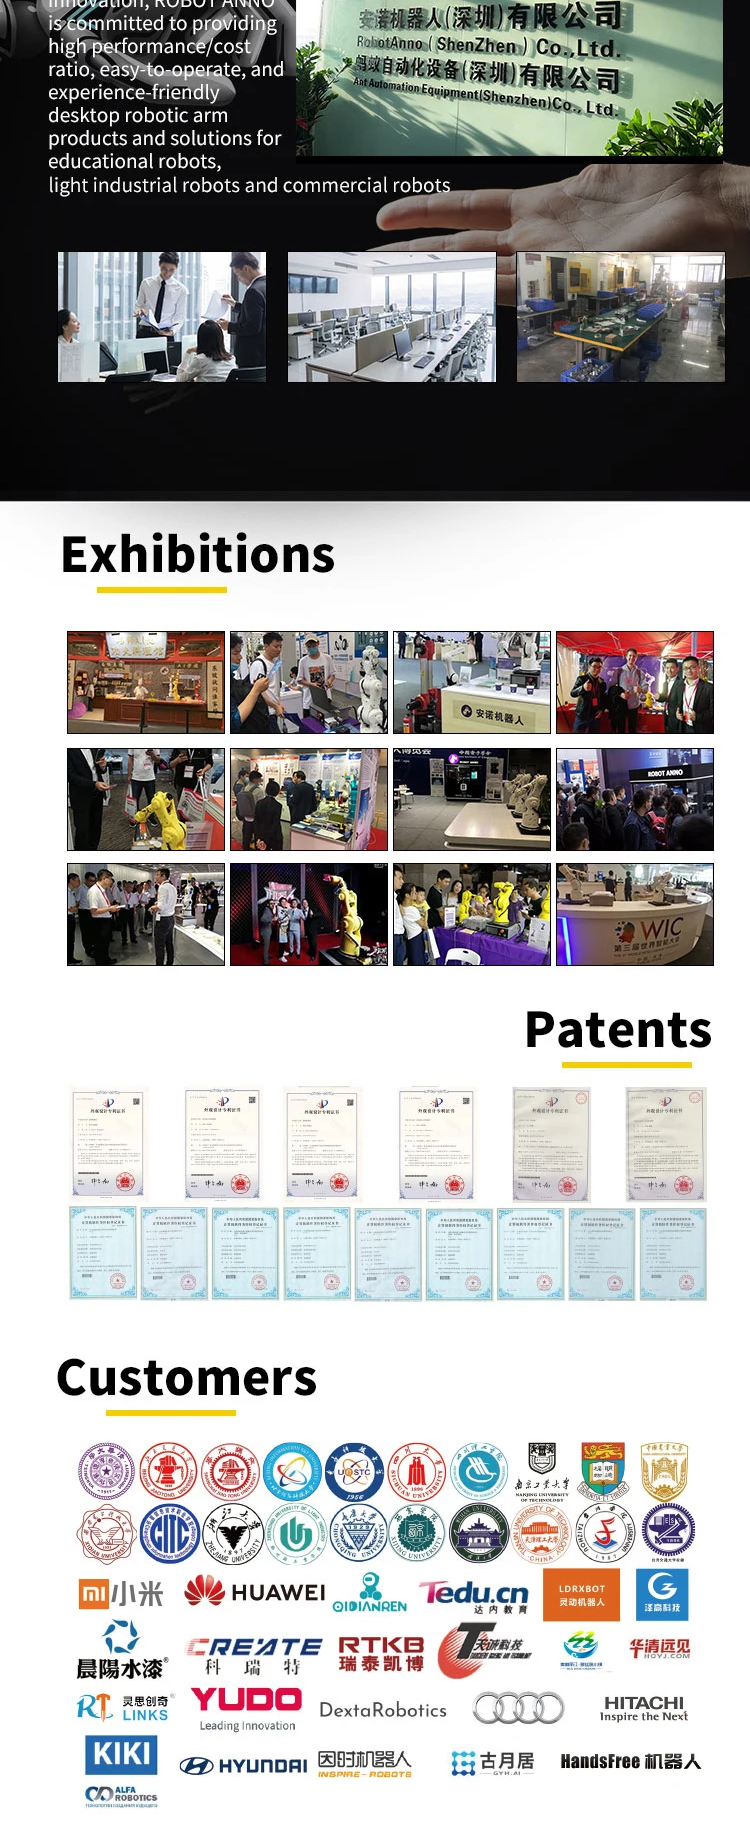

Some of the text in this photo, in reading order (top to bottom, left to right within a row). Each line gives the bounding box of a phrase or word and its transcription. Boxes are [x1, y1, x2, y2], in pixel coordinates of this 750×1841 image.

[359, 0, 621, 30] 安诺机器人(深圳)有限公司
[357, 36, 423, 51] RobotAnno
[437, 37, 516, 53] ShenZhen
[536, 37, 621, 58] Co.,Ltd.
[355, 54, 620, 94] 蚂蚁自动化设备(深圳)有限公司
[353, 76, 367, 87] Ant
[369, 78, 420, 93] Automation
[586, 101, 618, 117] Ltd.
[476, 708, 524, 726] 安诺机器人
[640, 917, 683, 941] WIC
[614, 937, 680, 952] 第三届世界智能大会
